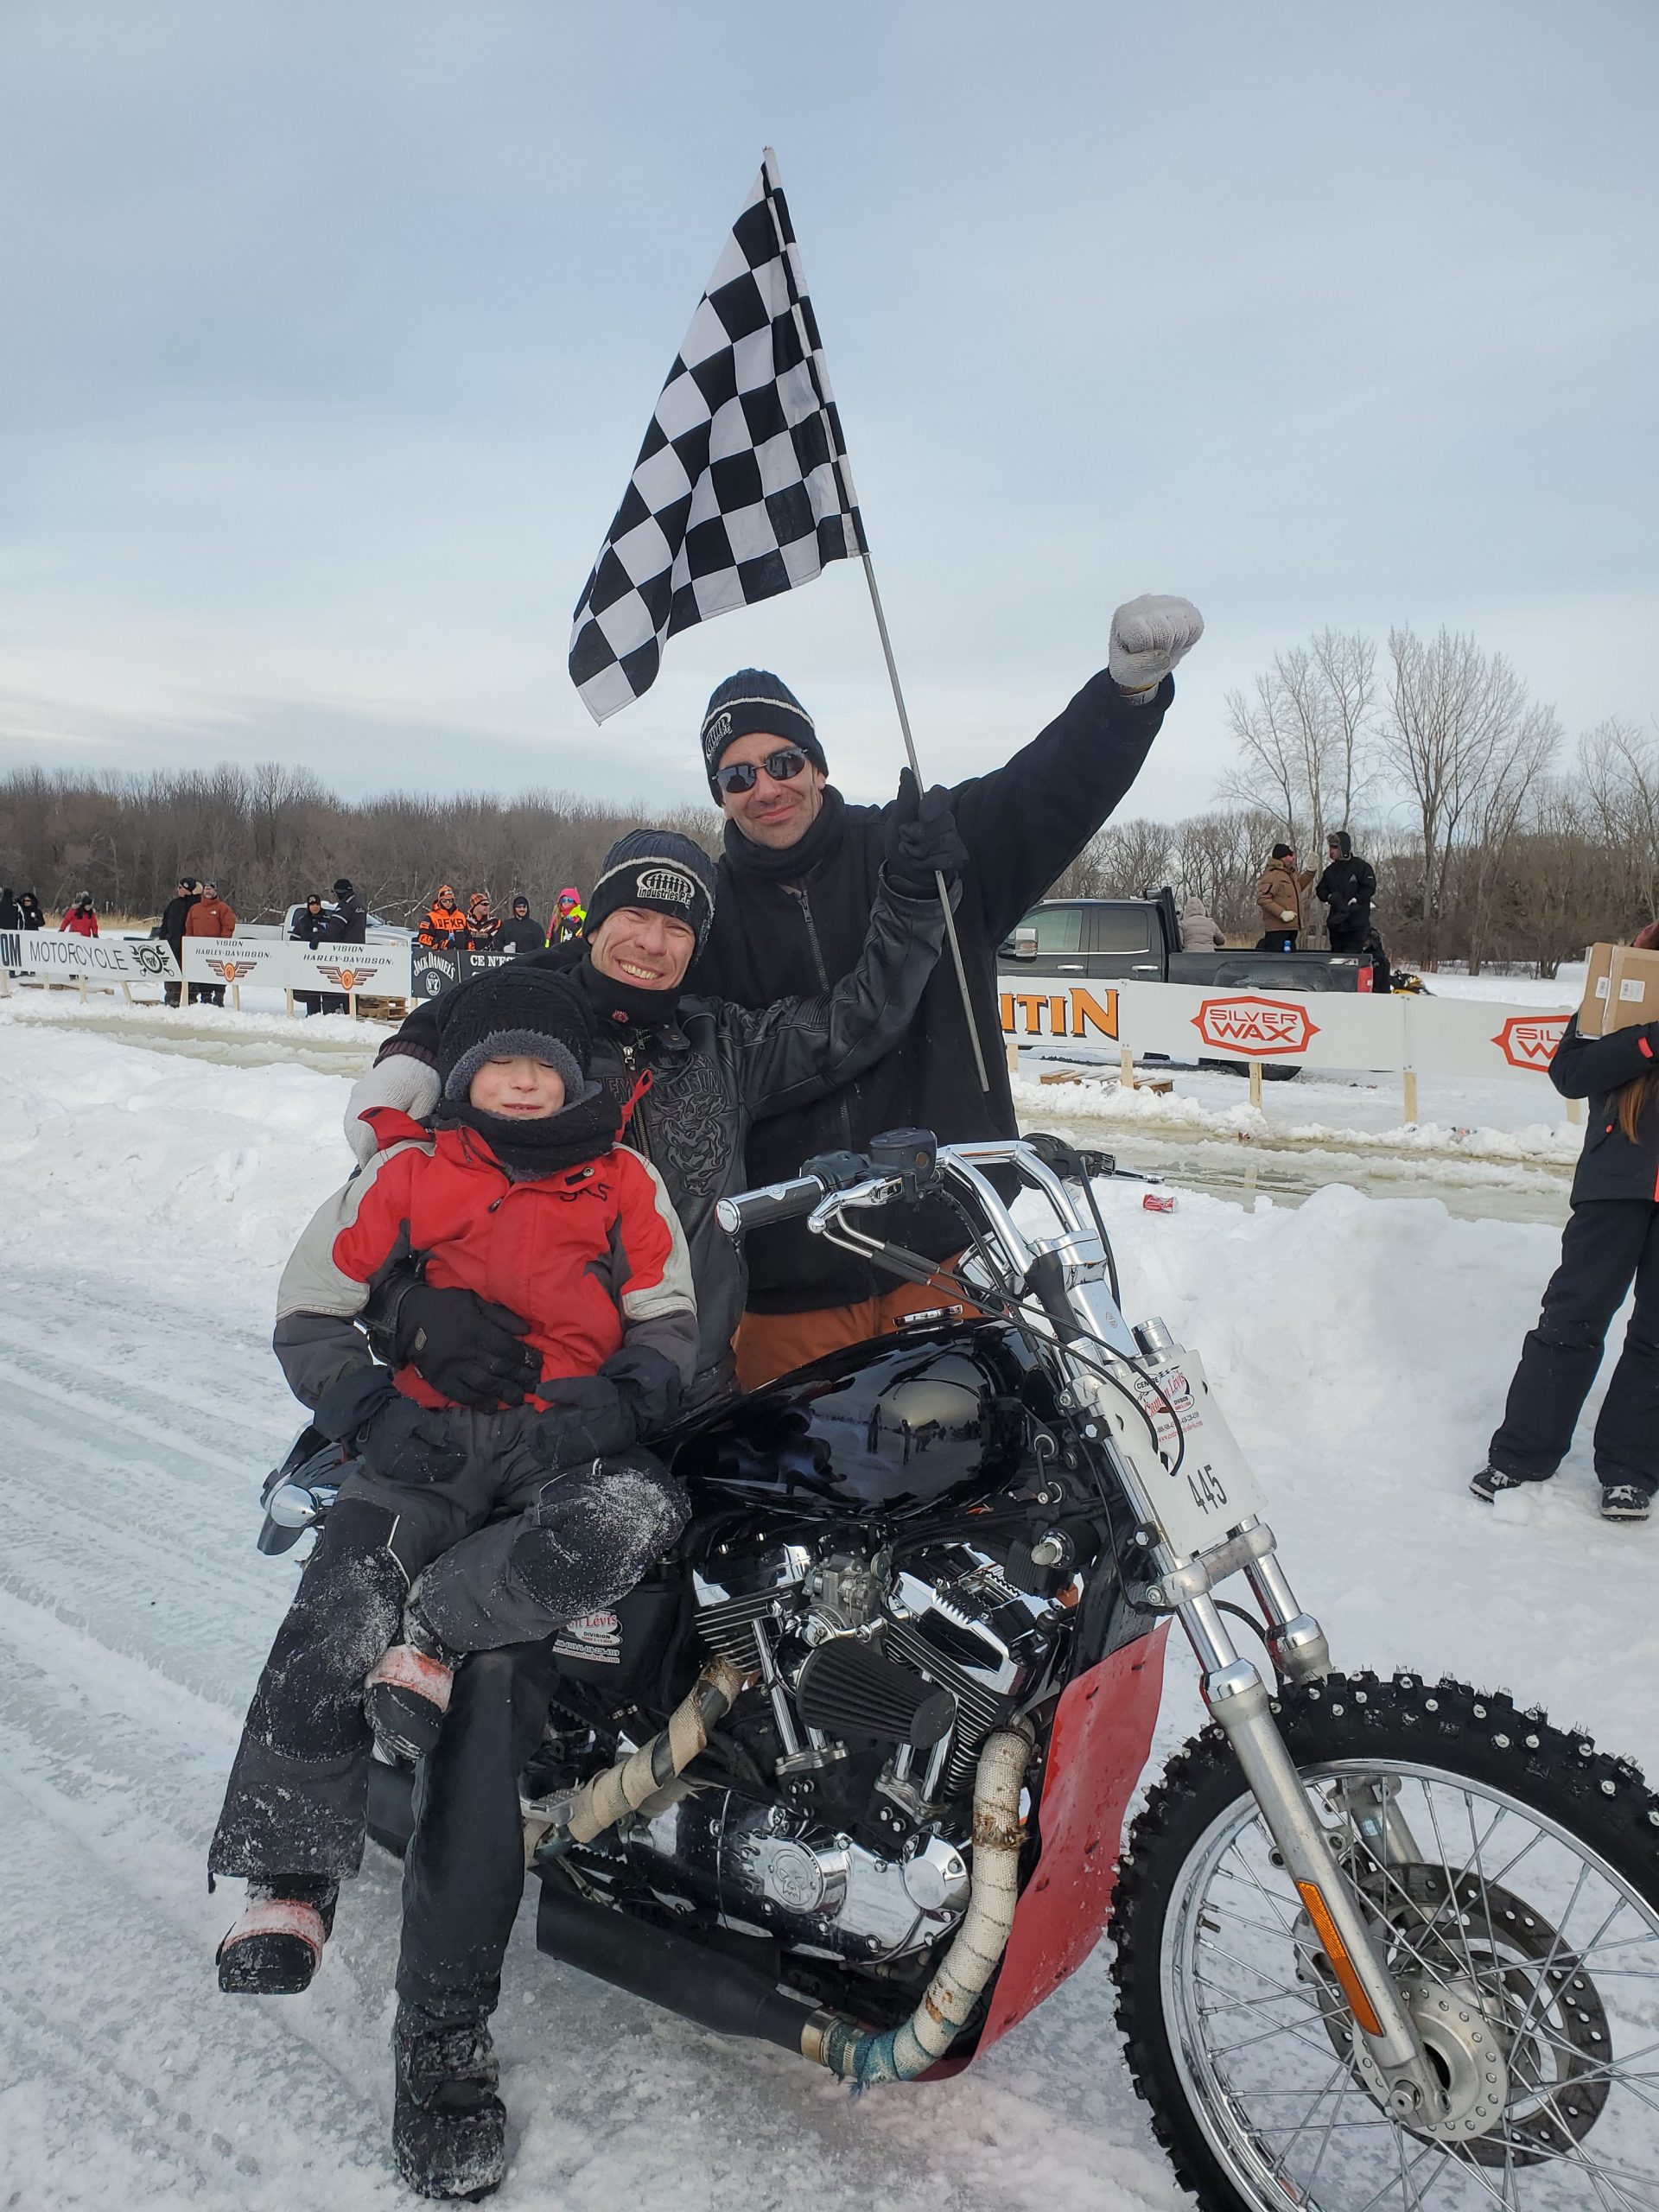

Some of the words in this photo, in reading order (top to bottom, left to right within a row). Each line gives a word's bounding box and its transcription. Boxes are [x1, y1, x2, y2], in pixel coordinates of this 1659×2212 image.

[215, 939, 244, 948] VISION
[333, 944, 364, 953] VISION
[29, 940, 129, 970] MOTORCYCLE
[195, 948, 270, 959] HARLEY-DAVIDSON
[303, 953, 391, 965] HARLEY-DAVIDSON
[470, 955, 485, 967] CE
[413, 954, 429, 976] JACK
[1210, 1008, 1298, 1026] SILVER
[1211, 1020, 1298, 1044] WAX
[1186, 1464, 1228, 1515] 445
